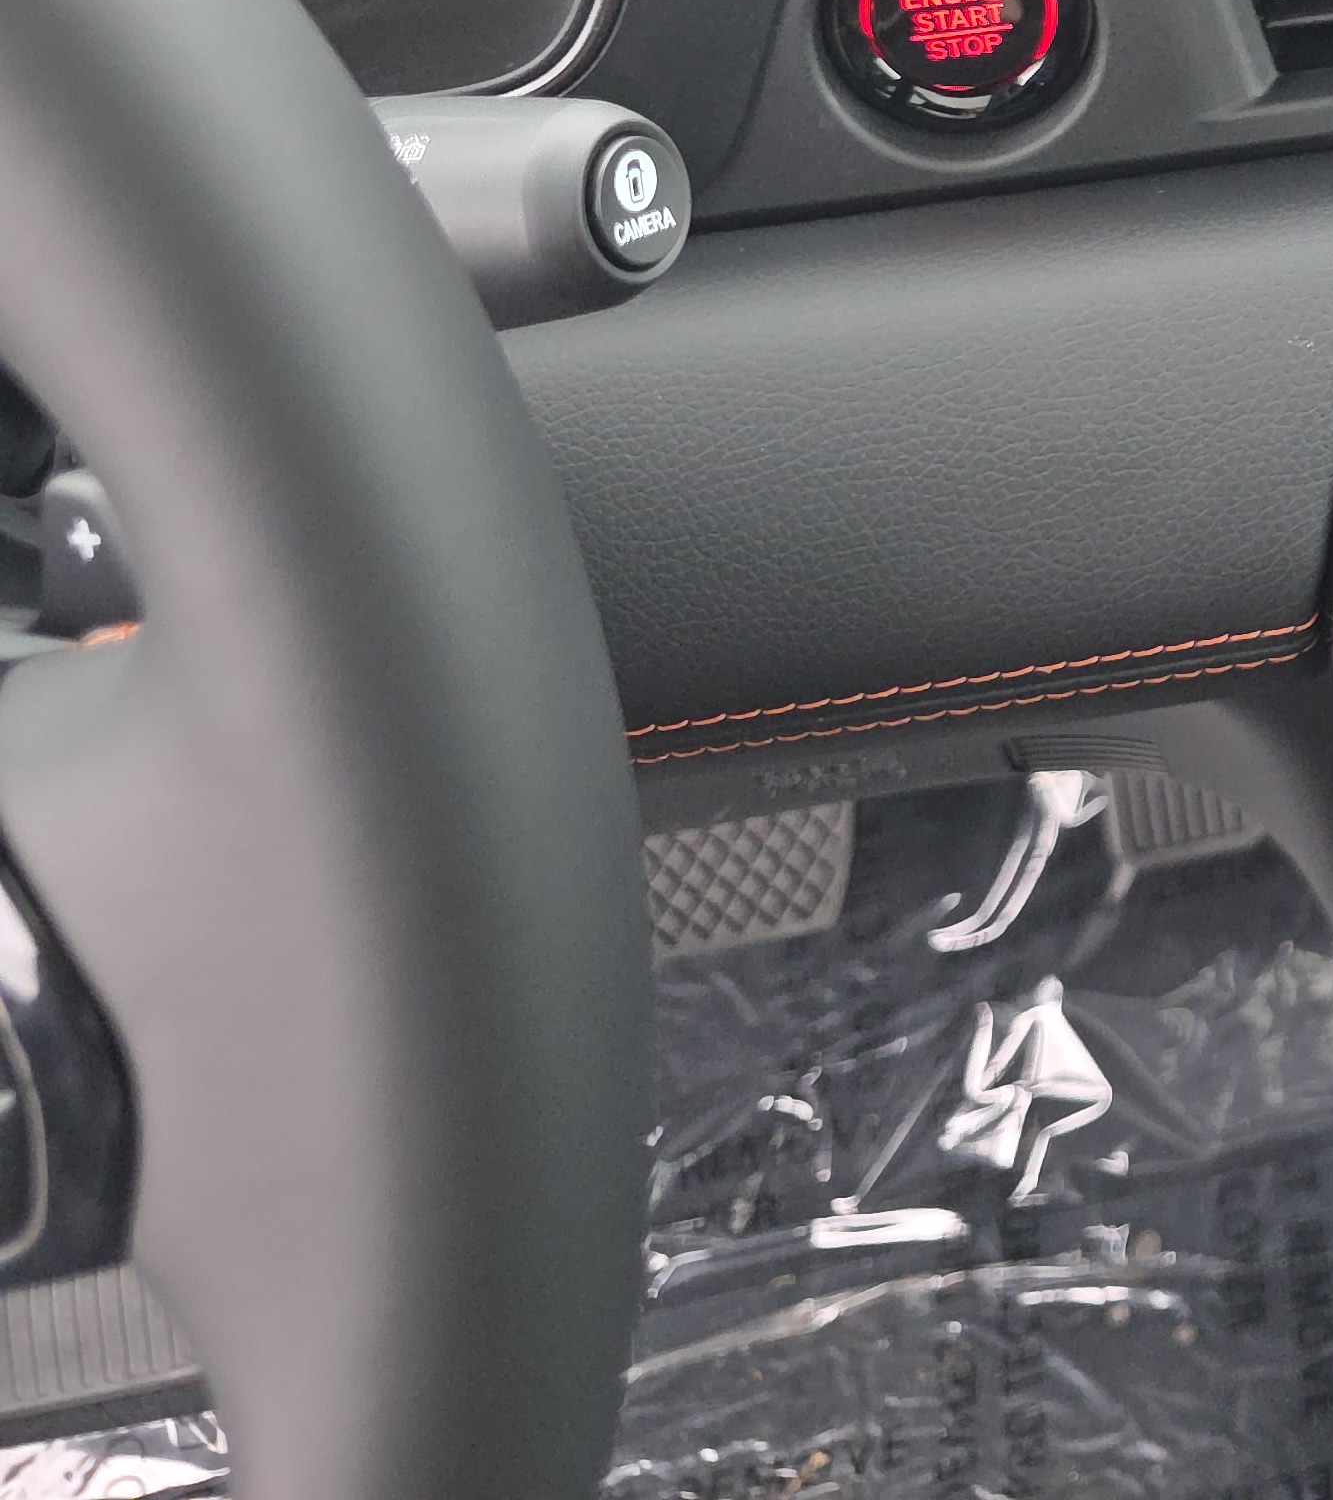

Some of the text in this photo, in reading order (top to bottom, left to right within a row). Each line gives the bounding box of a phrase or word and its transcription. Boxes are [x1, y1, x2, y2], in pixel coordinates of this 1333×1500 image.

[911, 2, 1005, 34] START
[925, 33, 1003, 62] STOP
[613, 206, 677, 246] CAMERA
